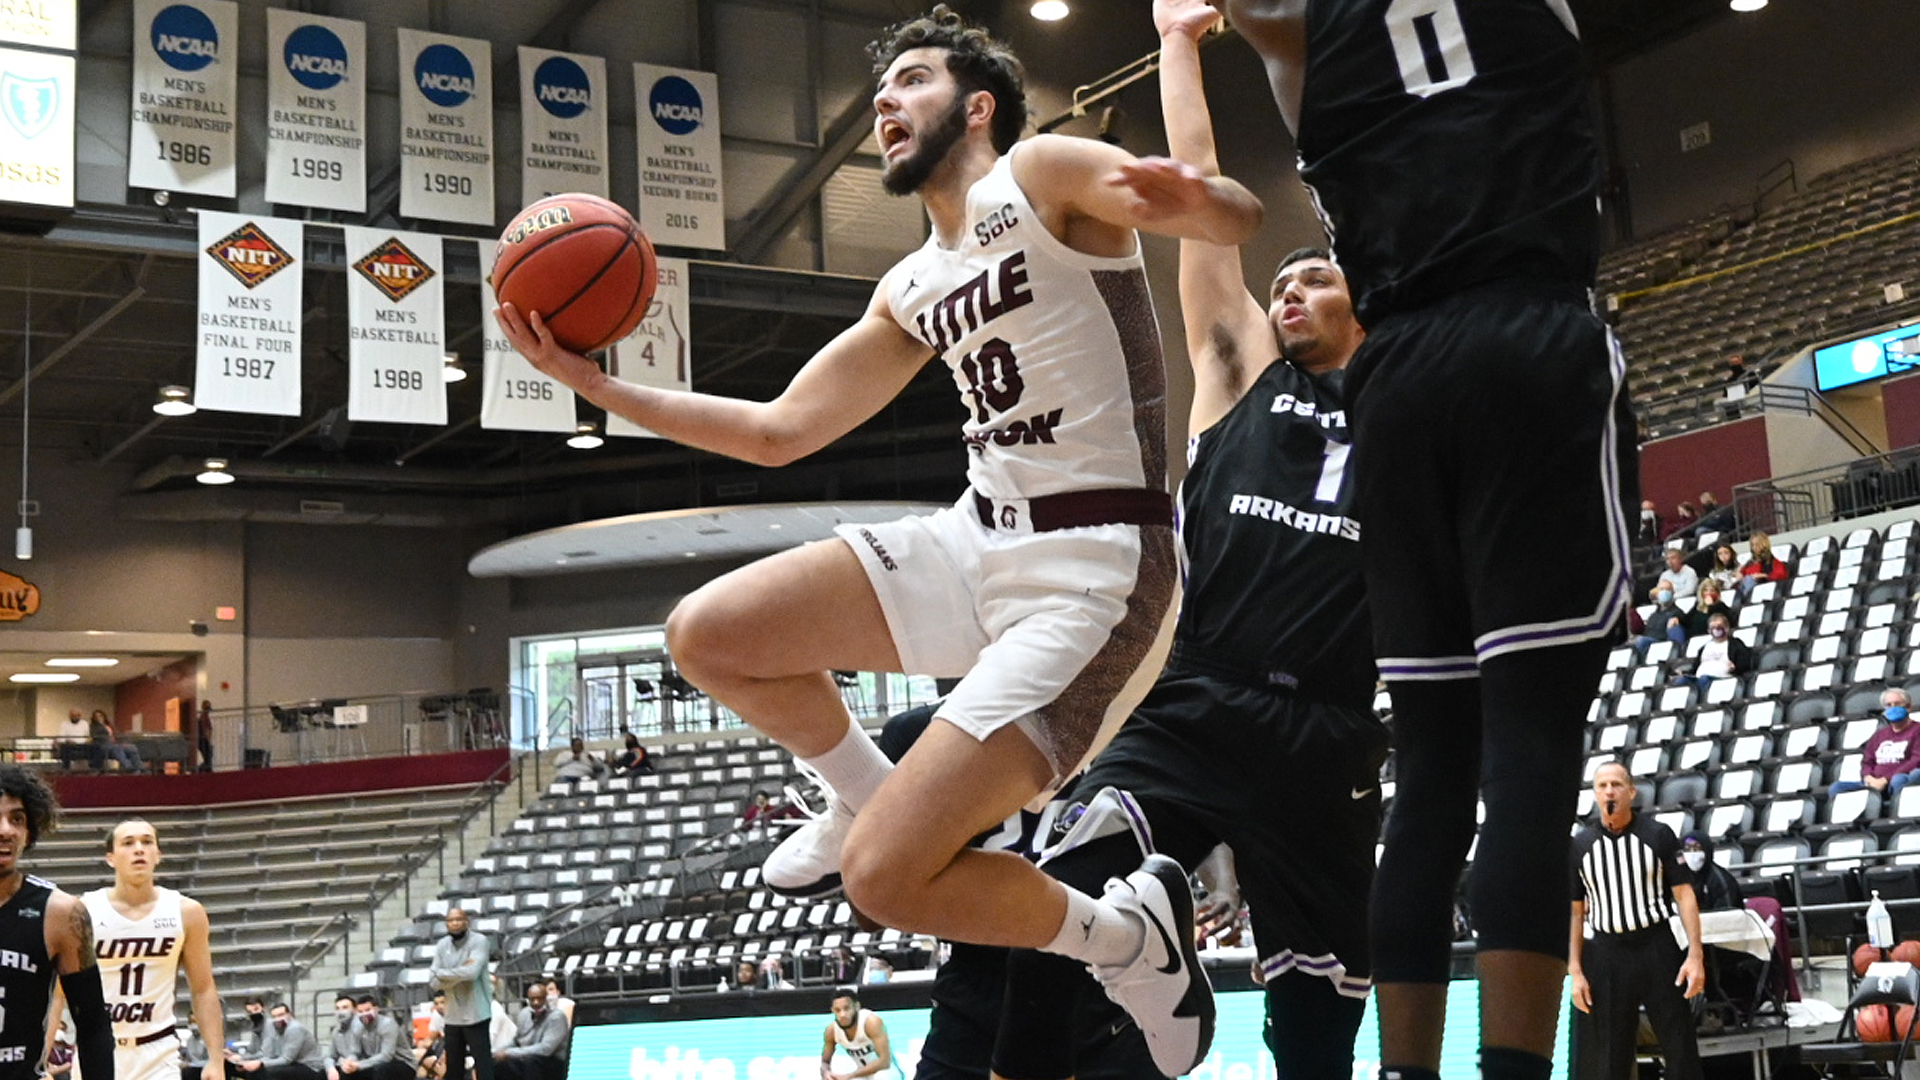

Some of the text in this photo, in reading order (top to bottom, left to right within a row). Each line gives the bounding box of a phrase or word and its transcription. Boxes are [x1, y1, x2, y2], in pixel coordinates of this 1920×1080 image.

[158, 34, 218, 56] NCAA
[1383, 0, 1477, 99] 0
[289, 53, 348, 75] NCAA
[164, 77, 206, 93] MEN'S
[420, 72, 475, 93] NCAA
[140, 92, 228, 116] BASKETBALL
[297, 95, 337, 111] MEN'S
[540, 85, 590, 104] NCAA
[133, 110, 233, 134] CHAMPIONSHIP
[273, 110, 357, 132] BASKETBALL
[427, 113, 465, 128] MEN'S
[655, 104, 701, 122] NCAA
[268, 127, 363, 150] CHAMPIONSHIP
[406, 127, 485, 148] BASKETBALL
[549, 130, 580, 144] MEN'S
[157, 141, 211, 166] 1986
[401, 145, 490, 165] CHAMPIONSHIP
[531, 143, 597, 160] BASKETBALL
[664, 144, 694, 157] MEN'S
[290, 157, 343, 181] 1989
[526, 157, 601, 175] CHAMPIONSHIP
[647, 156, 712, 173] BASKETBALL
[423, 173, 472, 196] 1990
[643, 185, 680, 199] SECOND
[666, 212, 698, 229] 2016
[974, 202, 1019, 247] SBC
[227, 247, 277, 266] NIT
[374, 262, 419, 280] NIT
[228, 295, 271, 311] MEN'S
[916, 250, 1034, 355] LITTLE
[201, 312, 295, 334] BASKETBALL
[375, 309, 417, 324] MEN'S
[204, 333, 292, 353] FINAL FOUR
[351, 327, 439, 345] BASKETBALL
[641, 341, 656, 367] 4
[223, 357, 275, 380] 1987
[374, 368, 423, 390] 1988
[506, 380, 553, 401] 1996
[961, 337, 1025, 424] 10
[1314, 438, 1352, 503] 1
[1229, 494, 1361, 542] ARKANS
[95, 937, 175, 959] LITTLE
[120, 963, 146, 996] 11
